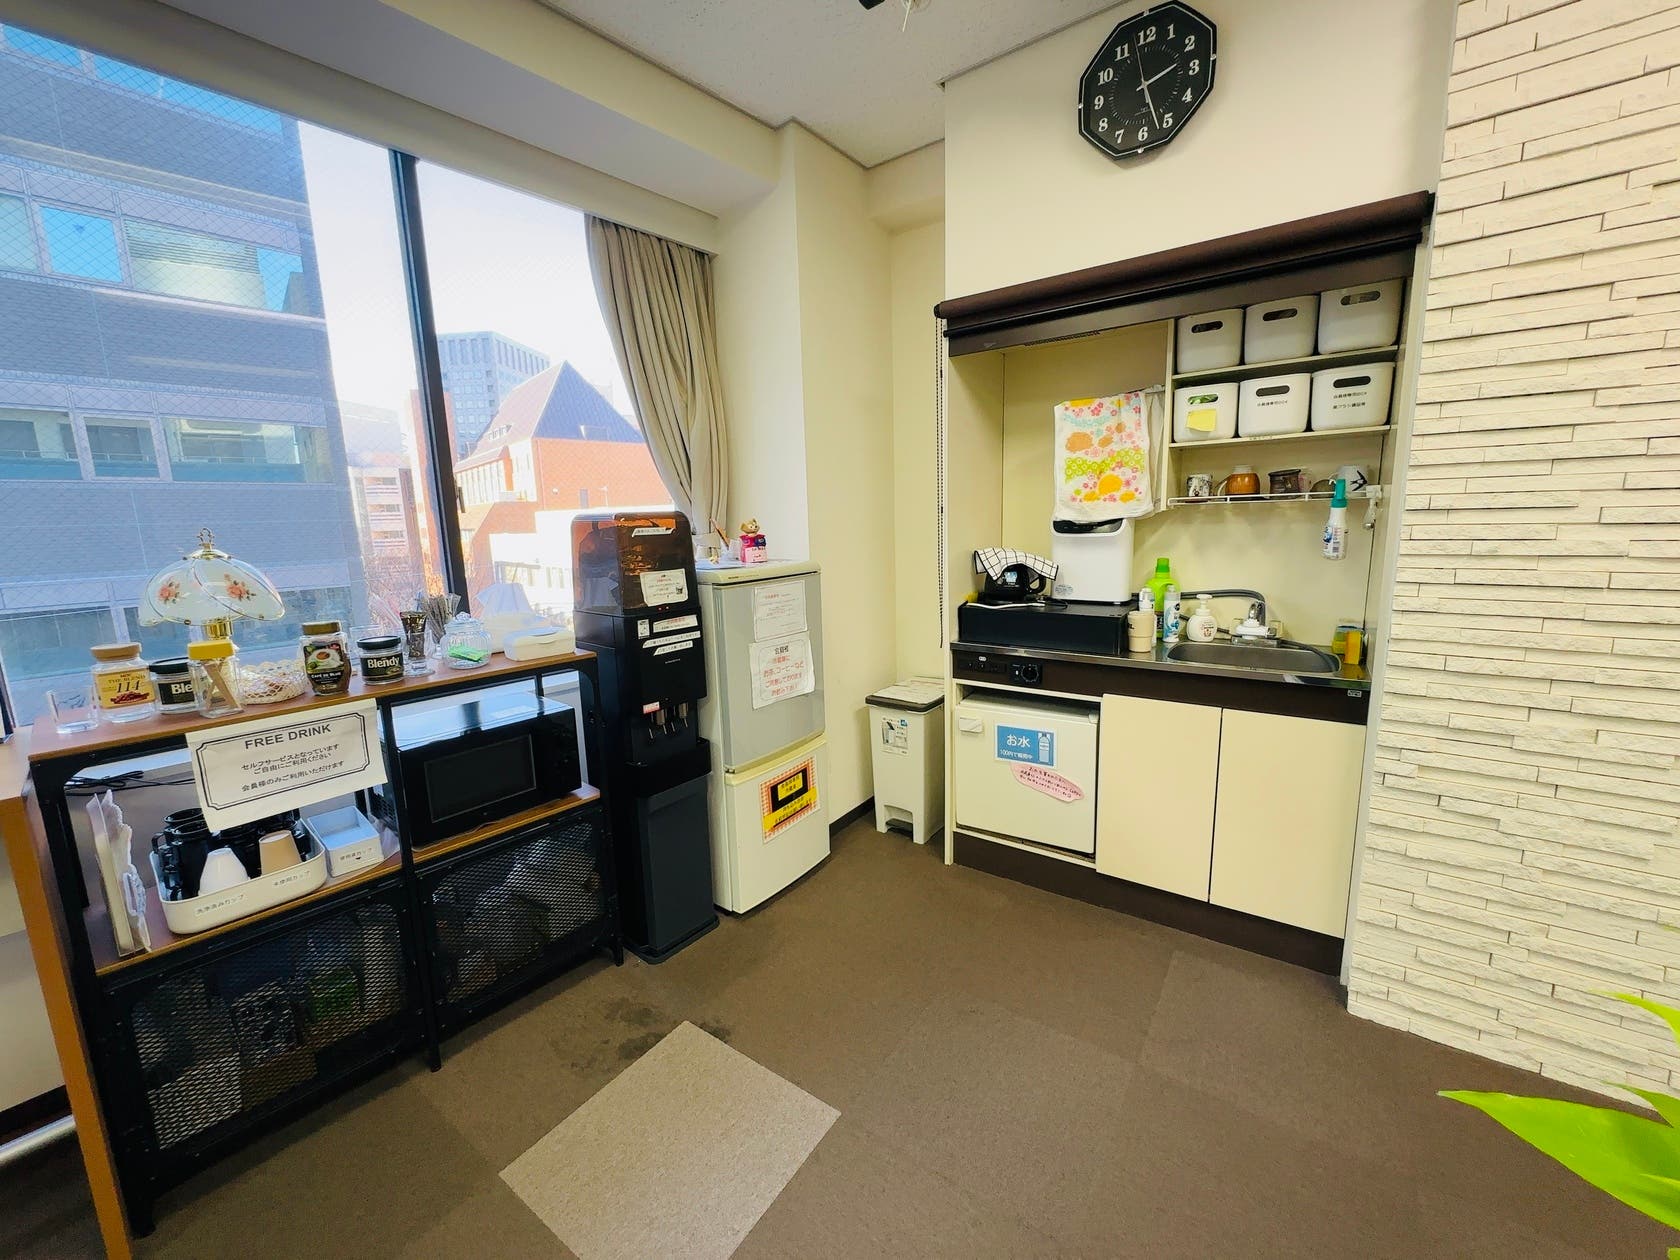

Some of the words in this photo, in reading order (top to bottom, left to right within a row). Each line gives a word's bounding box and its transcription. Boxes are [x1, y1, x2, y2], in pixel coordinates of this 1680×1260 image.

[1137, 26, 1157, 46] 12
[1167, 24, 1176, 40] 1
[1184, 35, 1196, 52] 2
[1114, 43, 1130, 62] 11
[1188, 59, 1200, 76] 3
[1098, 68, 1114, 86] 10
[1094, 95, 1105, 110] 9
[1182, 87, 1193, 103] 4
[1098, 117, 1109, 132] 8
[1162, 112, 1174, 128] 5
[1114, 129, 1125, 144] 7
[1137, 126, 1148, 141] 6
[367, 656, 400, 669] Blendy
[116, 680, 141, 693] 114
[171, 683, 193, 695] Ble
[245, 733, 284, 750] FREE
[288, 723, 332, 740] DRINK
[1006, 733, 1031, 748] お水
[241, 743, 340, 771] セルフサービスとなっています
[253, 752, 332, 775] ご自由にご利用ください
[241, 760, 345, 792] 会員様のみご利用いただけます
